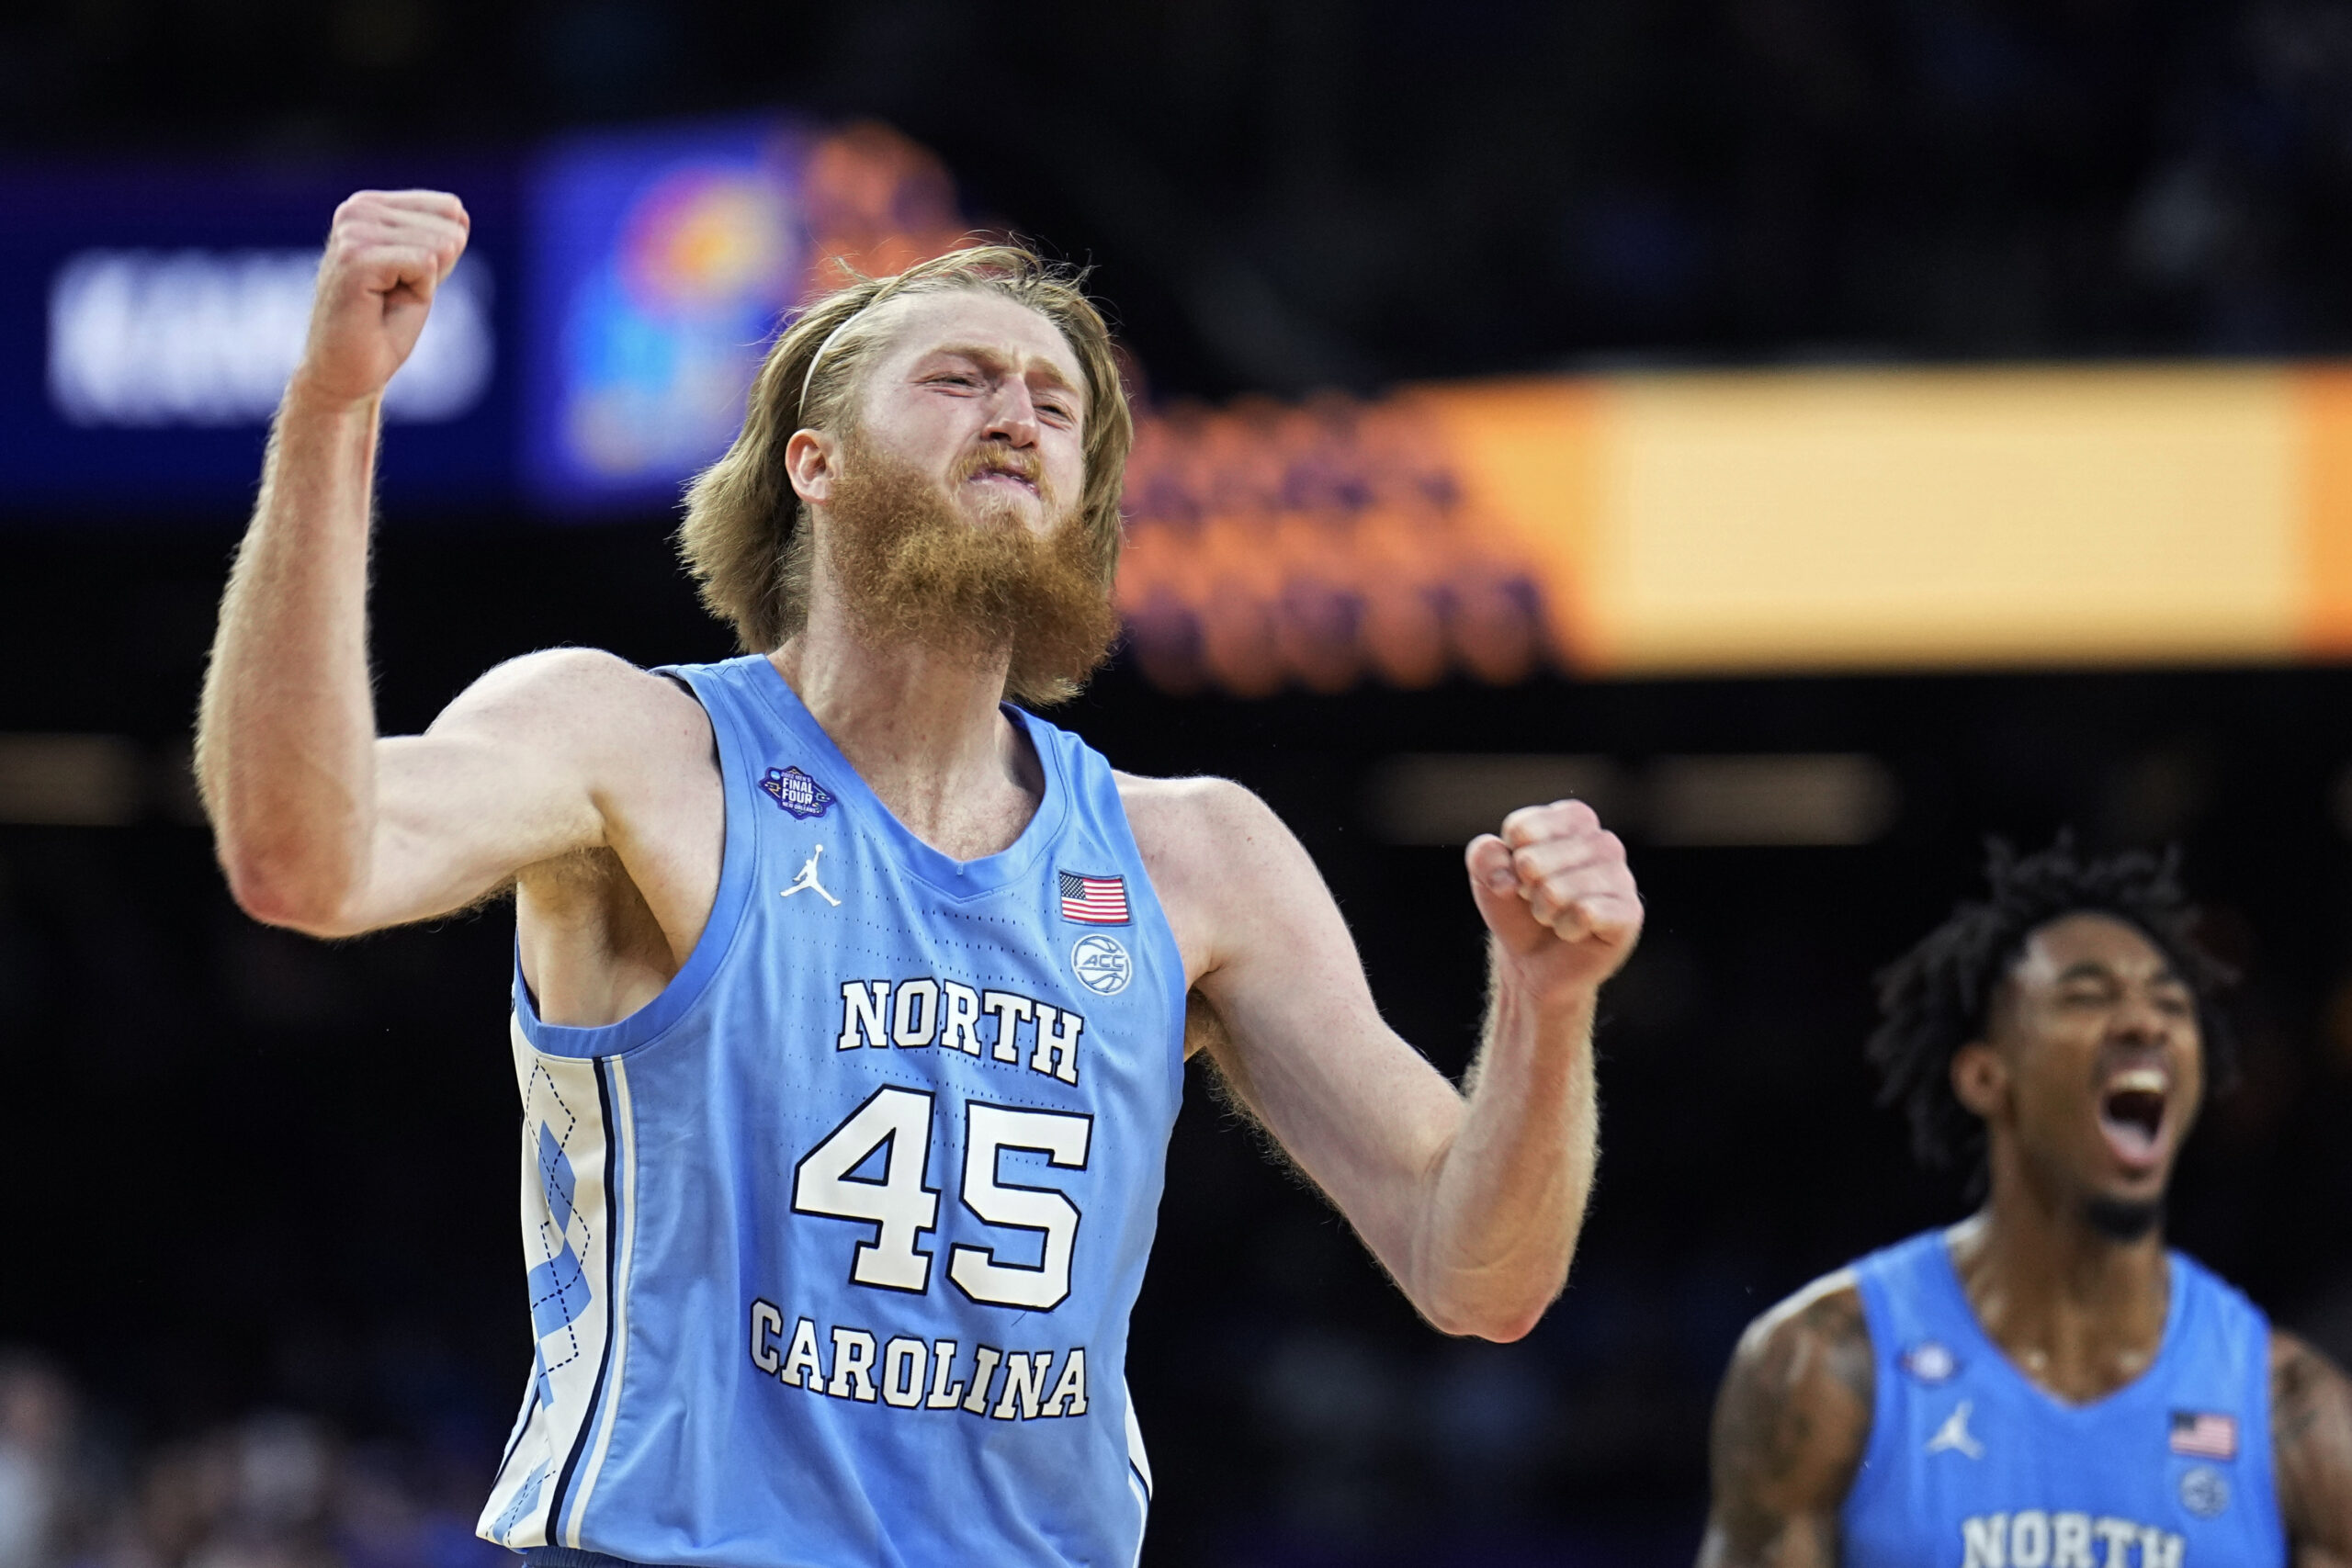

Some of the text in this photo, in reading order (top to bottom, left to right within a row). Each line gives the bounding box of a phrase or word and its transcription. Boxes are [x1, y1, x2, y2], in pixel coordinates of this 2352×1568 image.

[782, 787, 813, 805] FOUR
[783, 777, 814, 794] FINAL
[1083, 953, 1126, 967] ACC
[837, 977, 1084, 1087] NORTH
[791, 1084, 1093, 1312] 45
[751, 1298, 1089, 1420] CAROLINA
[1962, 1511, 2184, 1568] NORTH
